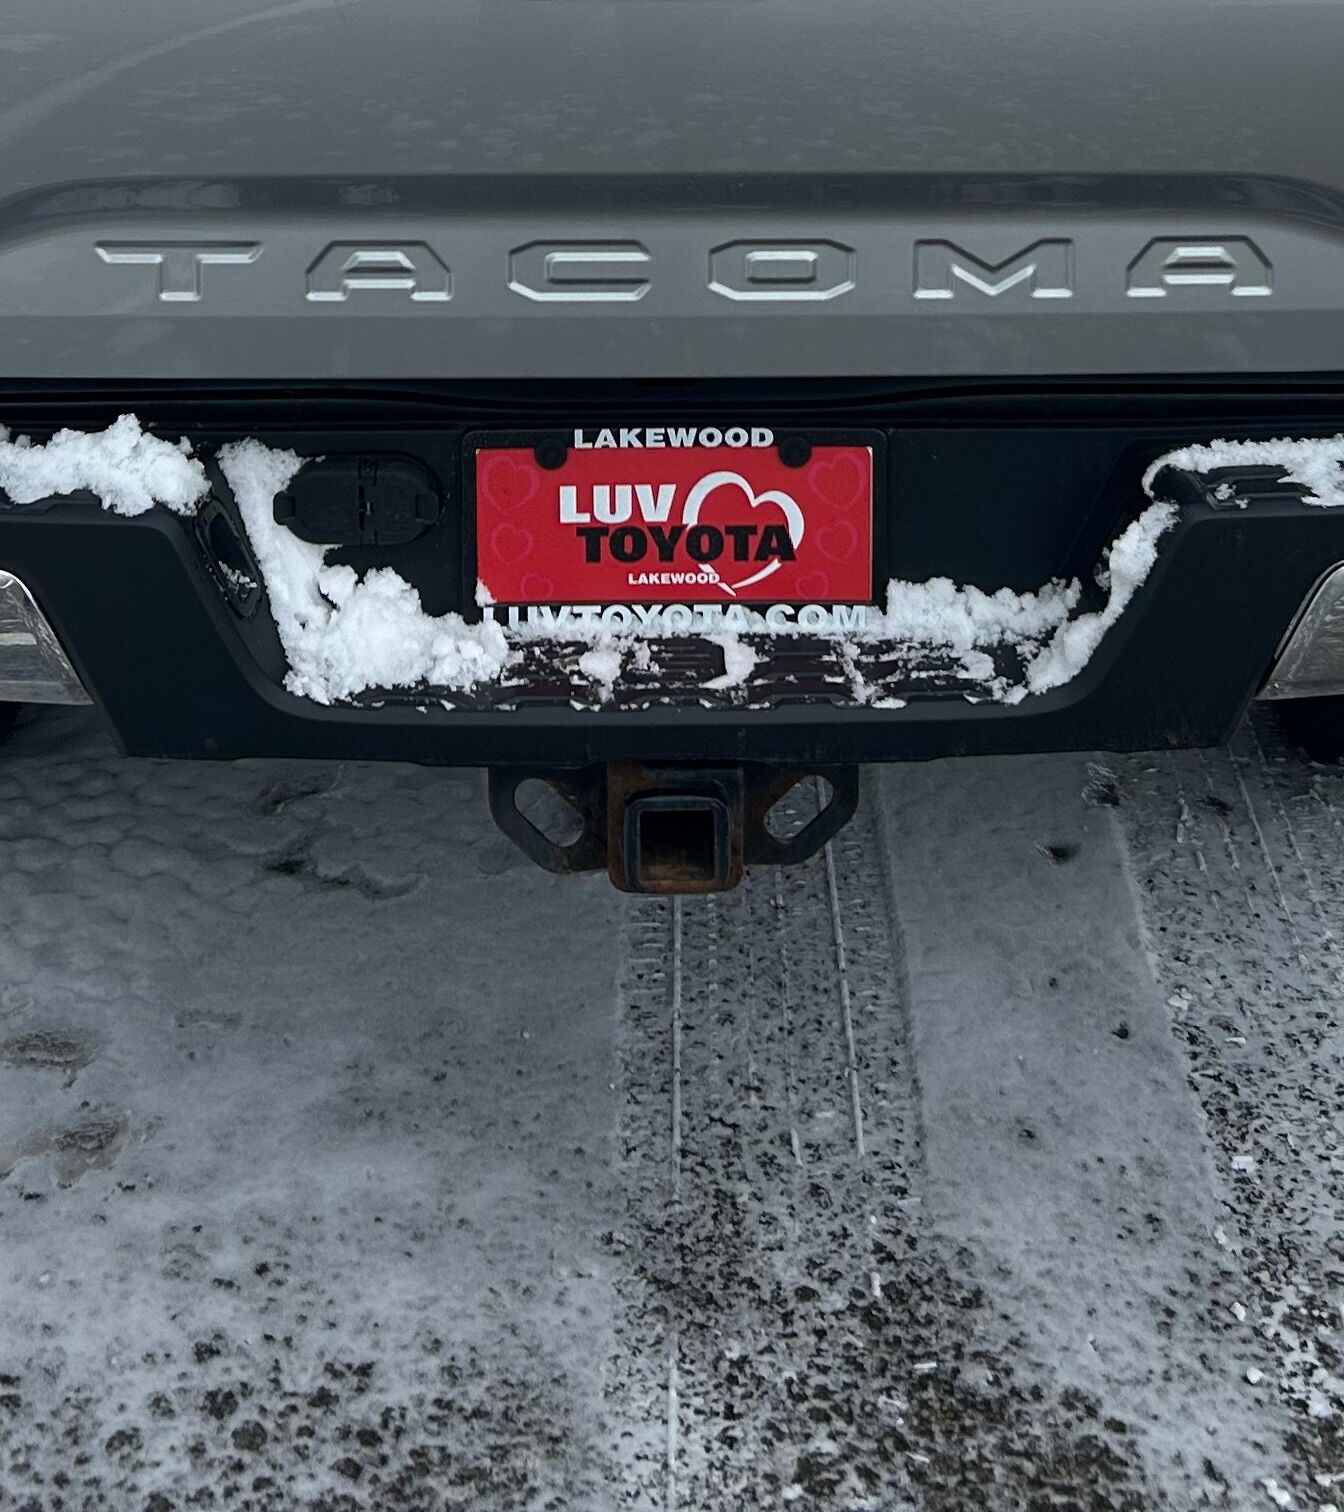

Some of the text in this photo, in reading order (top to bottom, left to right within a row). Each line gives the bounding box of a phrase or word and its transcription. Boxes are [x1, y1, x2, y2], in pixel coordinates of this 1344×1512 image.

[94, 235, 1273, 302] TACOMA
[575, 427, 774, 449] LAKEWOOD
[559, 484, 676, 523] LUV
[576, 524, 797, 563] TOYOTA
[628, 572, 721, 586] LAKEWOOD
[483, 604, 867, 631] UVTOYOTACOM
